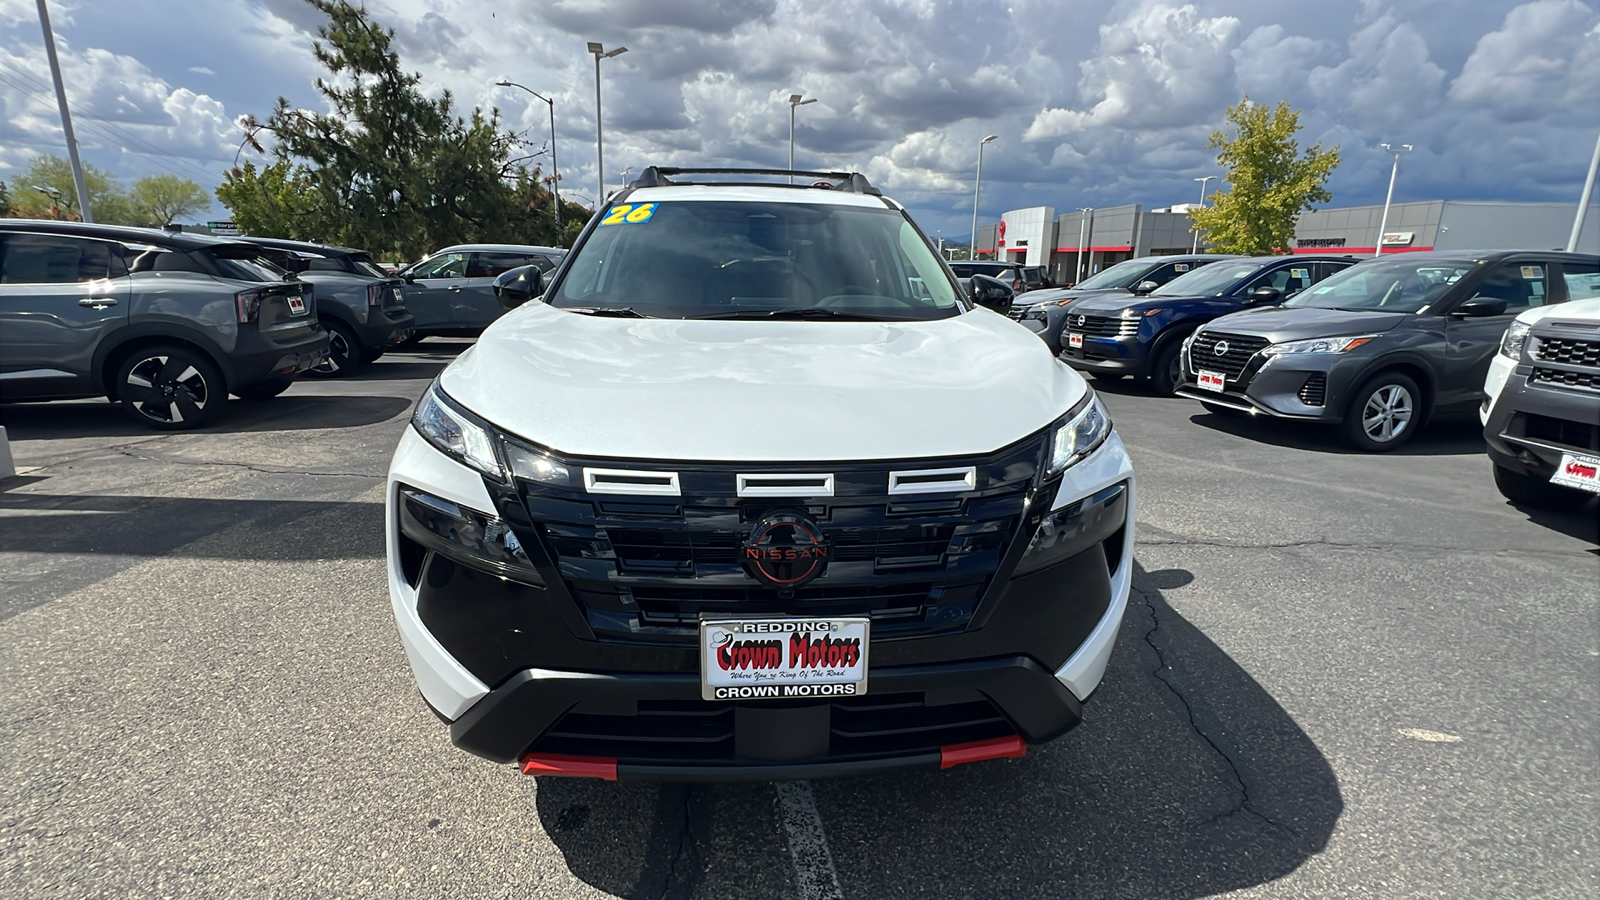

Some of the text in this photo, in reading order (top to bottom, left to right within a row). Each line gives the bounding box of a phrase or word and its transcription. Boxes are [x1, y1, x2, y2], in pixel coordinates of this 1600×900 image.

[602, 203, 655, 225] 26
[746, 547, 827, 560] NISSAN
[743, 622, 829, 633] REDDING
[717, 632, 860, 671] Crown Motors
[753, 671, 777, 681] You're
[779, 671, 797, 679] King
[799, 670, 809, 679] Of
[716, 684, 855, 698] CROWN MOTORS
